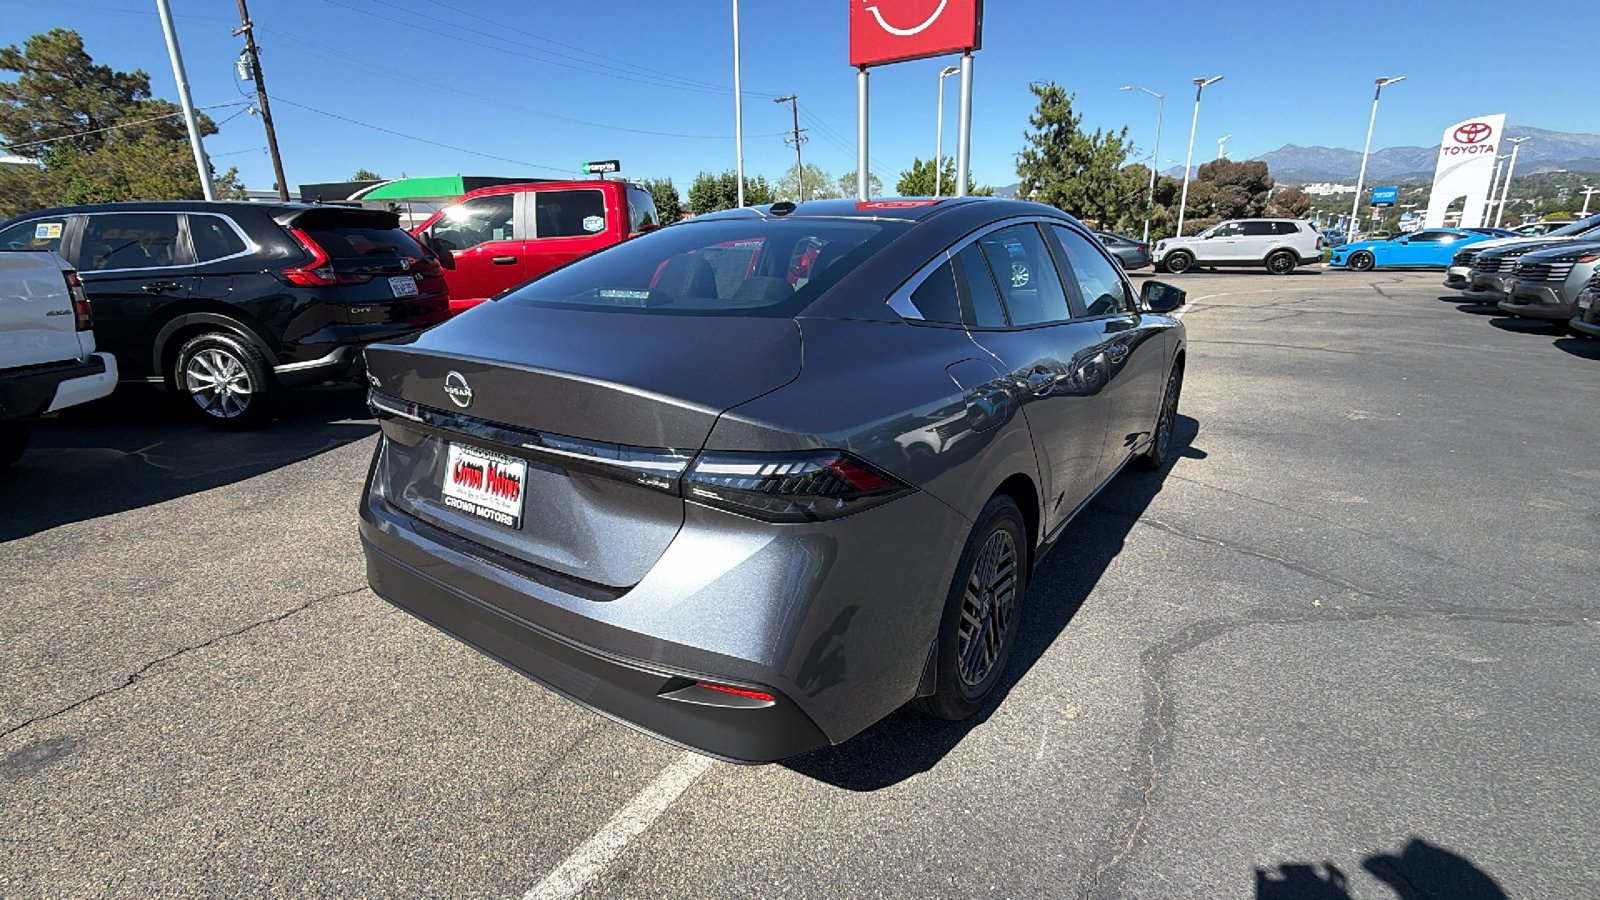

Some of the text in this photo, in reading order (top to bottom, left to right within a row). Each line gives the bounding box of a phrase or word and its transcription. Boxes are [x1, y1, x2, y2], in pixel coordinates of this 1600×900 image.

[1443, 144, 1494, 155] TOYOTA
[583, 162, 615, 172] enterprise
[453, 460, 483, 490] Crown
[485, 464, 520, 502] Motors
[445, 496, 475, 514] CROWN
[476, 506, 513, 526] MOTORS
